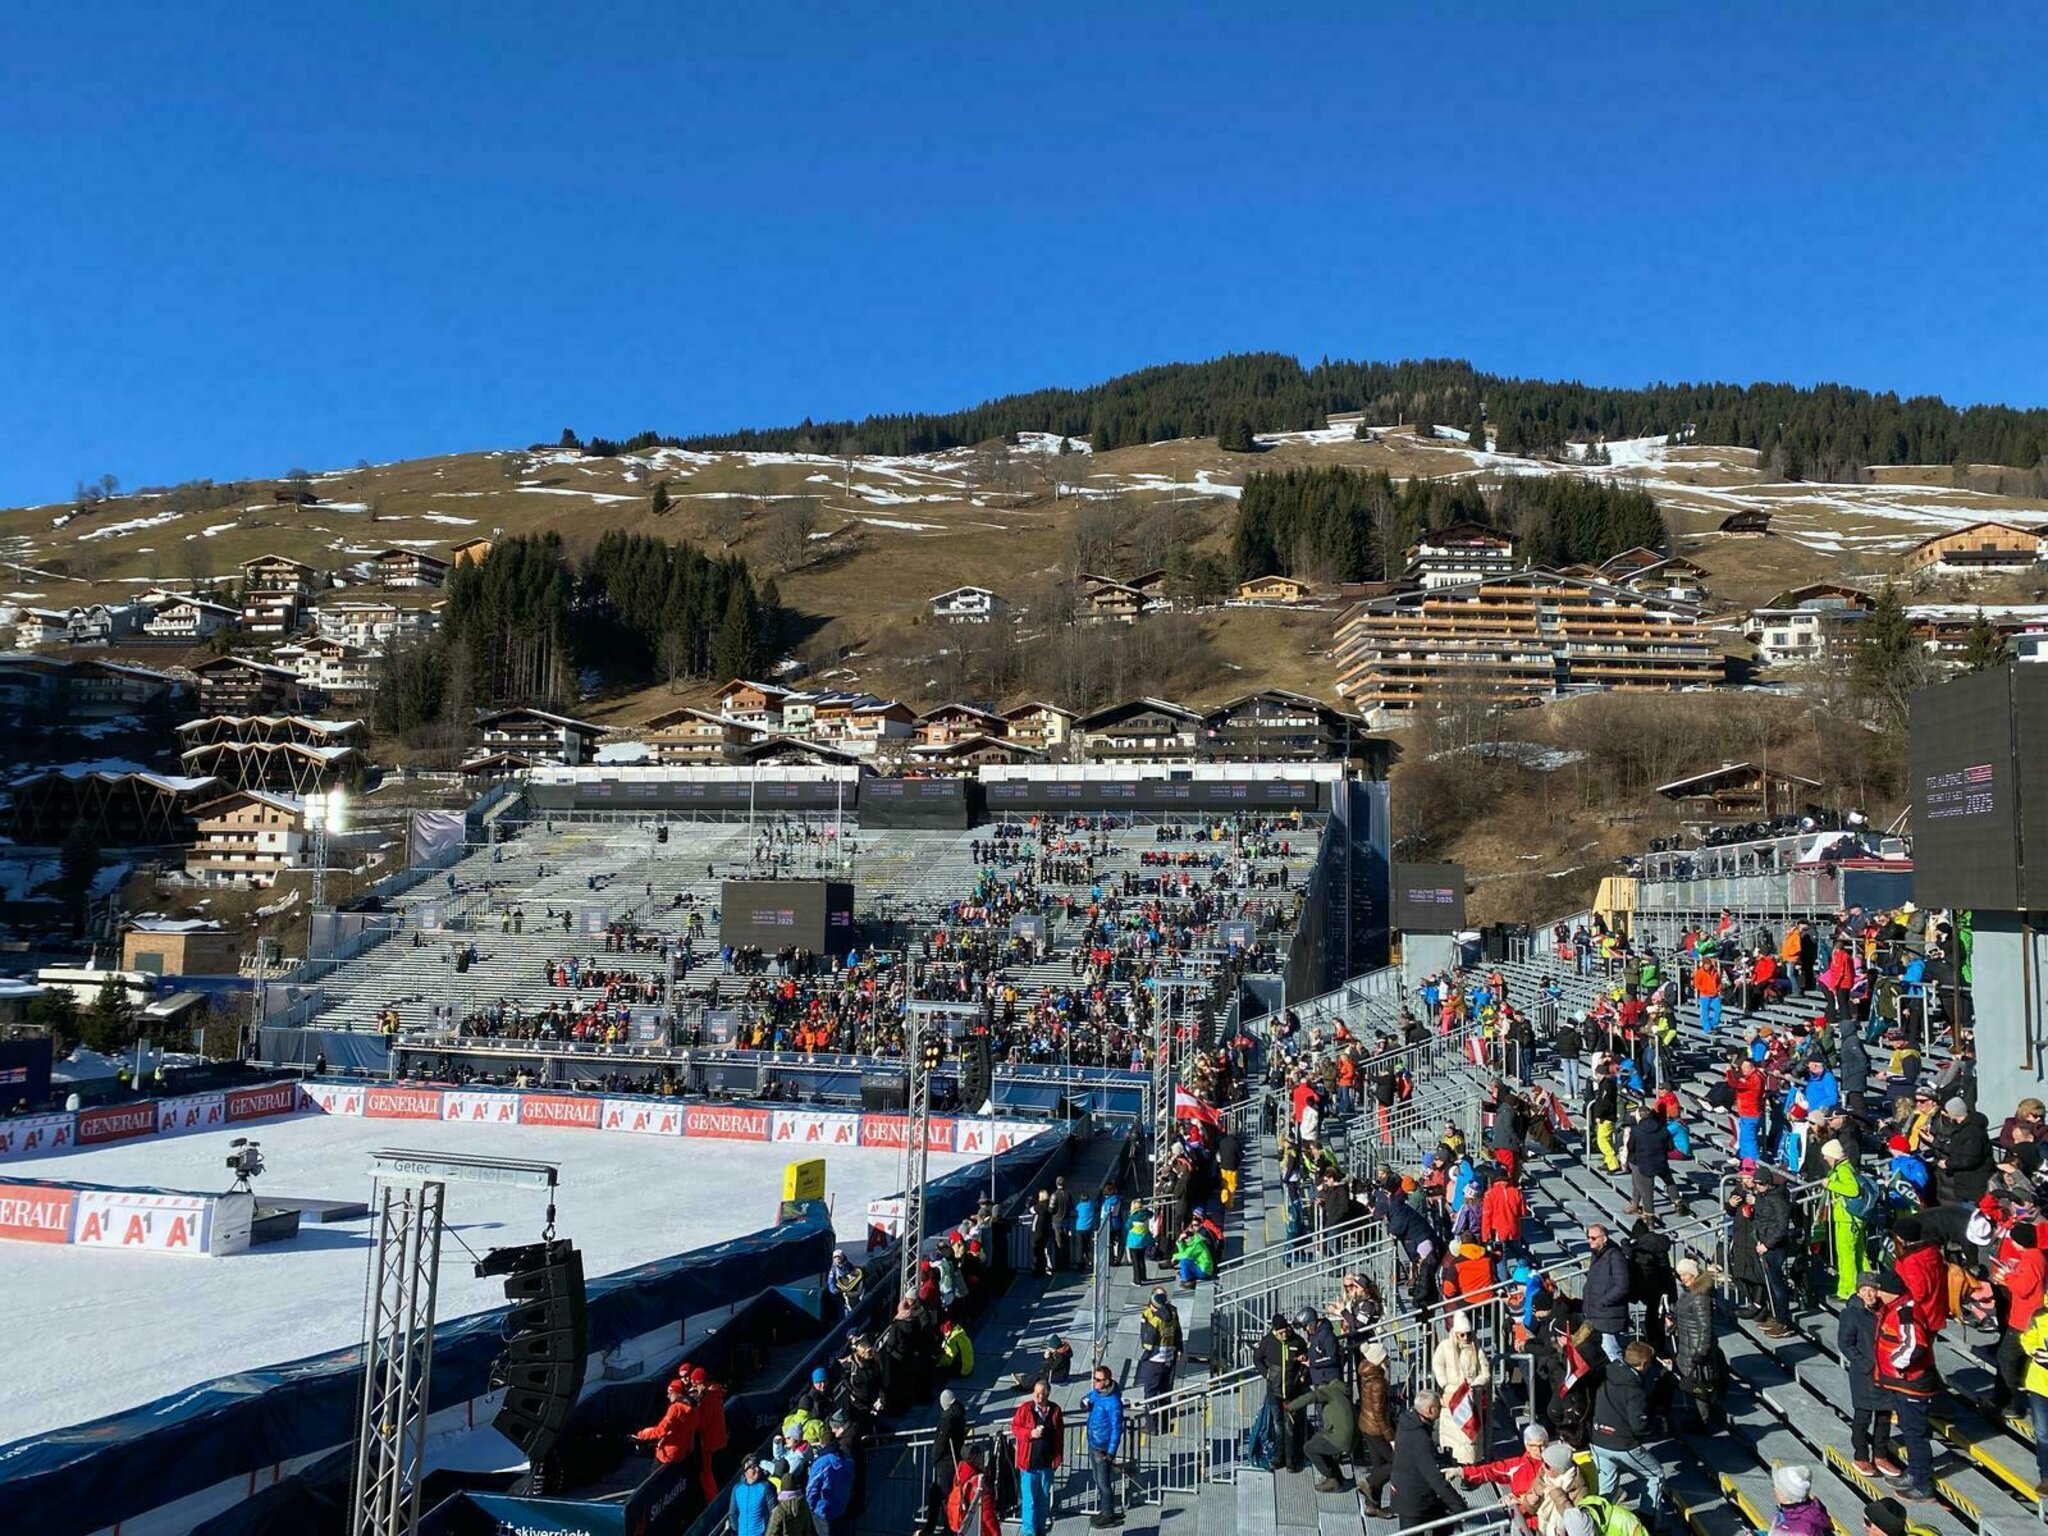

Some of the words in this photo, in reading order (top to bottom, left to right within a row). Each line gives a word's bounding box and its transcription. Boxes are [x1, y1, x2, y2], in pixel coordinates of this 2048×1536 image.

[230, 1091, 293, 1115] GENERALI
[322, 1094, 336, 1111] A1
[344, 1095, 360, 1113] A1
[368, 1095, 439, 1113] GENERALI
[448, 1100, 463, 1119] A1
[472, 1101, 488, 1120] A1
[498, 1101, 514, 1121] A1
[523, 1101, 599, 1122] GENERALI
[80, 1111, 154, 1136] GENERALI
[162, 1107, 177, 1130] A1
[185, 1105, 200, 1127] A1
[208, 1103, 222, 1124] A1
[606, 1109, 623, 1128] A1
[633, 1110, 650, 1130] A1
[659, 1112, 678, 1132] A1
[687, 1112, 767, 1134] GENERALI
[24, 1128, 43, 1151] A1
[52, 1124, 71, 1147] A1
[777, 1120, 795, 1140] A1
[806, 1121, 824, 1141] A1
[835, 1123, 853, 1143] A1
[864, 1119, 951, 1144] GENEALI
[964, 1130, 983, 1151] A1
[996, 1132, 1014, 1153] A1
[394, 1160, 431, 1175] Getec
[81, 1208, 110, 1242] A1
[123, 1211, 152, 1244] A1
[166, 1213, 196, 1247] A1
